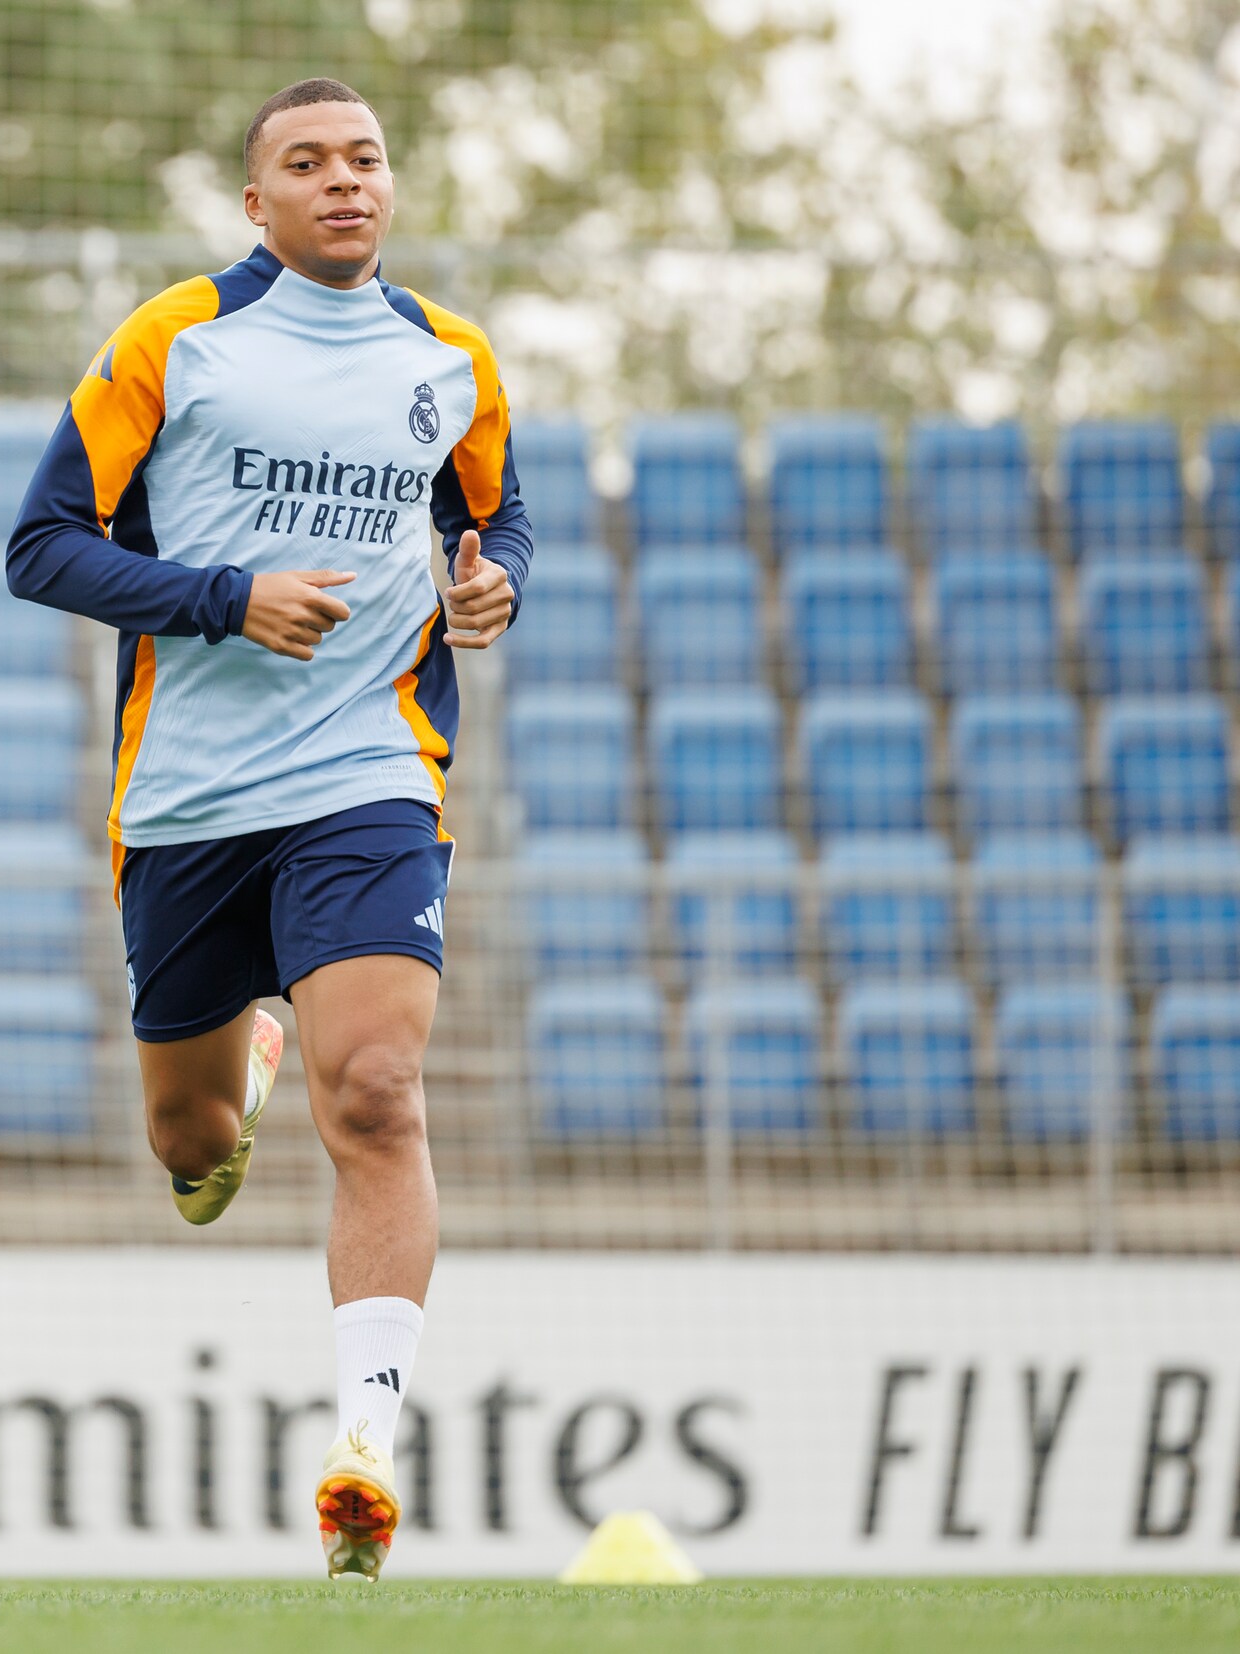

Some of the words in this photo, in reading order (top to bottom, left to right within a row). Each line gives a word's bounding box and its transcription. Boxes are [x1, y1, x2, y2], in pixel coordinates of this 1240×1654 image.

[232, 446, 429, 503] Emirates
[254, 499, 305, 535] FLY
[309, 502, 399, 545] BETTER
[860, 1363, 1081, 1541] FLY
[1130, 1365, 1240, 1544] B
